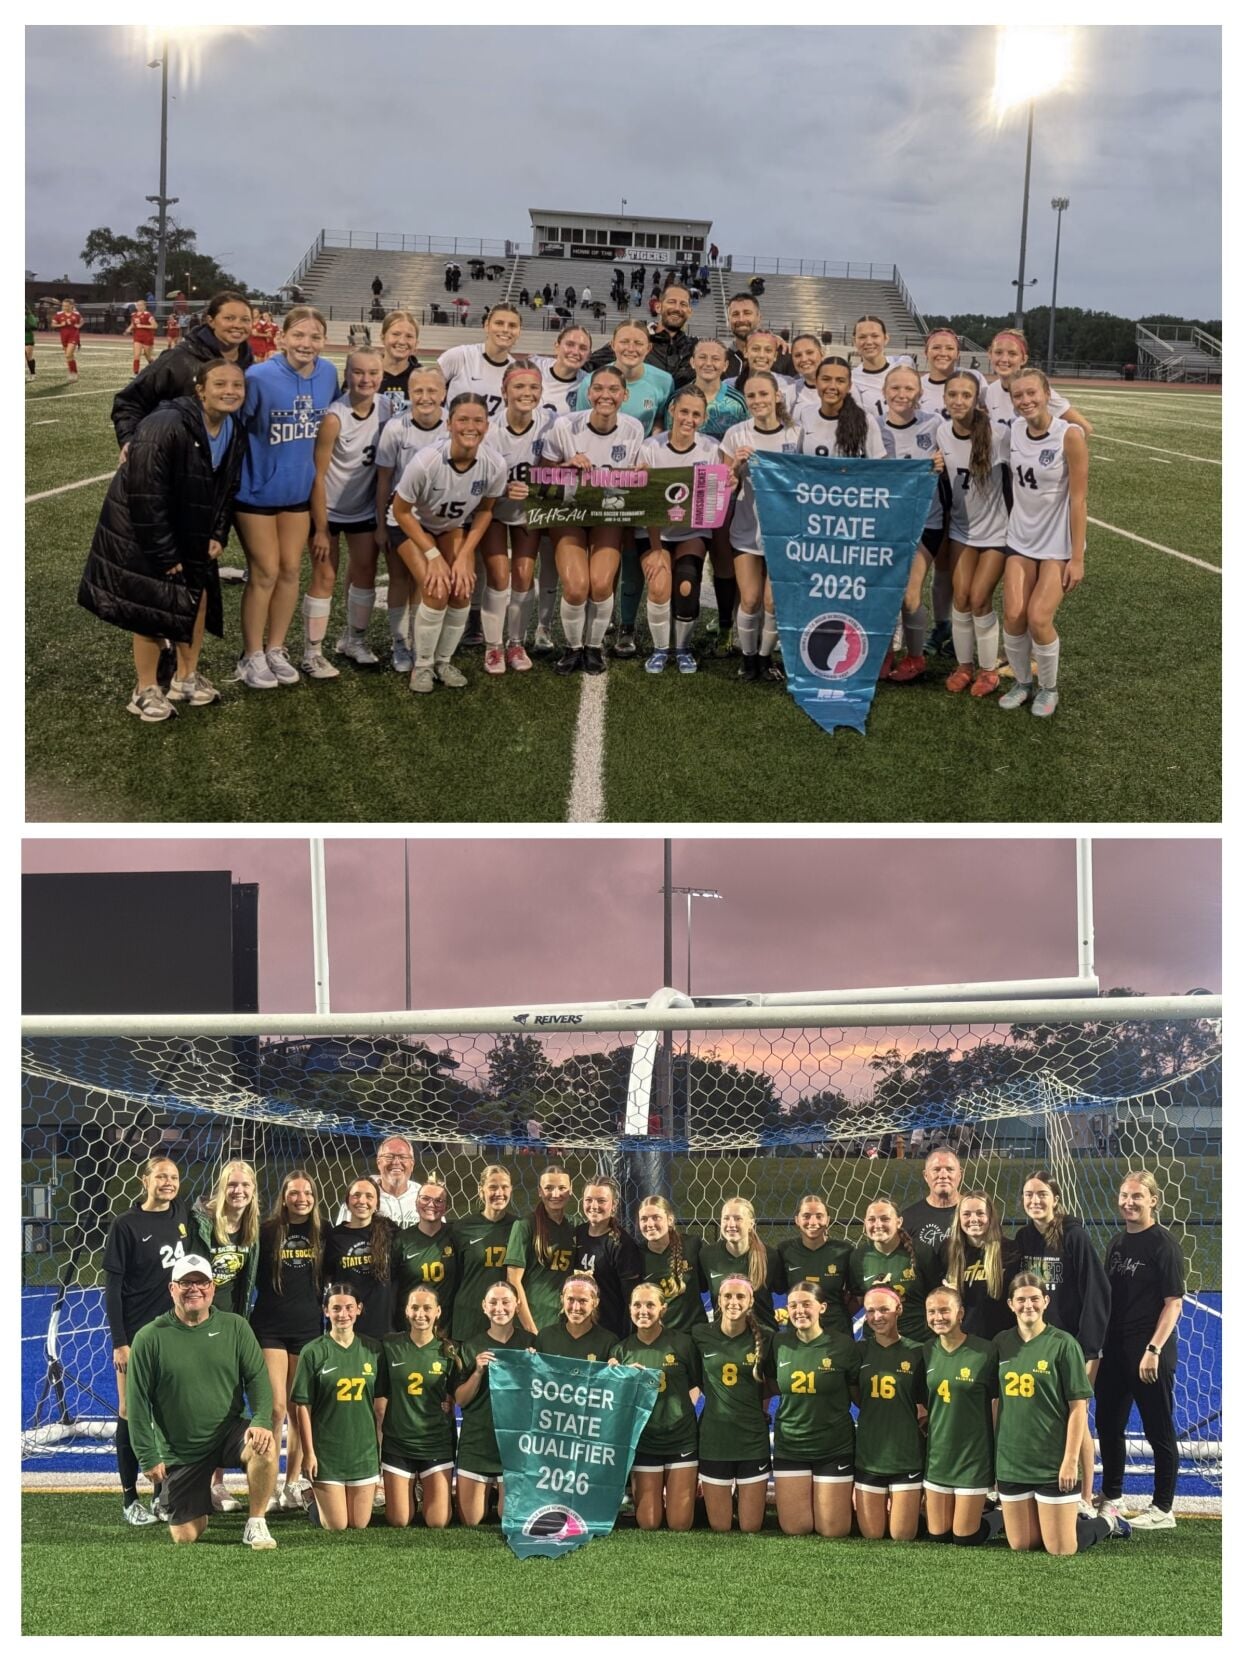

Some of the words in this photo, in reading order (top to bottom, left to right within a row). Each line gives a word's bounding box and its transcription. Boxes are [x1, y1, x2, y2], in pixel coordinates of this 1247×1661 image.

[630, 250, 667, 261] TIGERS
[362, 445, 376, 466] 3
[528, 466, 578, 486] TICKET
[581, 468, 649, 488] PUNCHED
[697, 468, 706, 489] TICKET
[957, 468, 970, 490] 7
[1016, 464, 1038, 490] 14
[796, 482, 890, 509] SOCCER
[435, 501, 467, 519] 15
[807, 513, 876, 539] STATE
[786, 540, 894, 566] QUALIFIER
[808, 573, 867, 600] 2026
[534, 1014, 583, 1026] REIVERS
[159, 1241, 186, 1269] 24
[341, 1255, 363, 1269] STATE
[484, 1246, 507, 1268] 17
[550, 1249, 573, 1271] 15
[580, 1253, 597, 1272] 44
[420, 1261, 445, 1282] 10
[407, 1372, 424, 1395] 2
[721, 1363, 738, 1387] 8
[790, 1370, 817, 1394] 21
[870, 1374, 897, 1400] 16
[1004, 1371, 1036, 1398] 28
[336, 1377, 367, 1401] 27
[530, 1378, 615, 1411] SOCCER
[936, 1379, 951, 1403] 4
[538, 1408, 603, 1438] STATE
[518, 1434, 616, 1466] QUALIFIER
[535, 1465, 590, 1496] 2026
